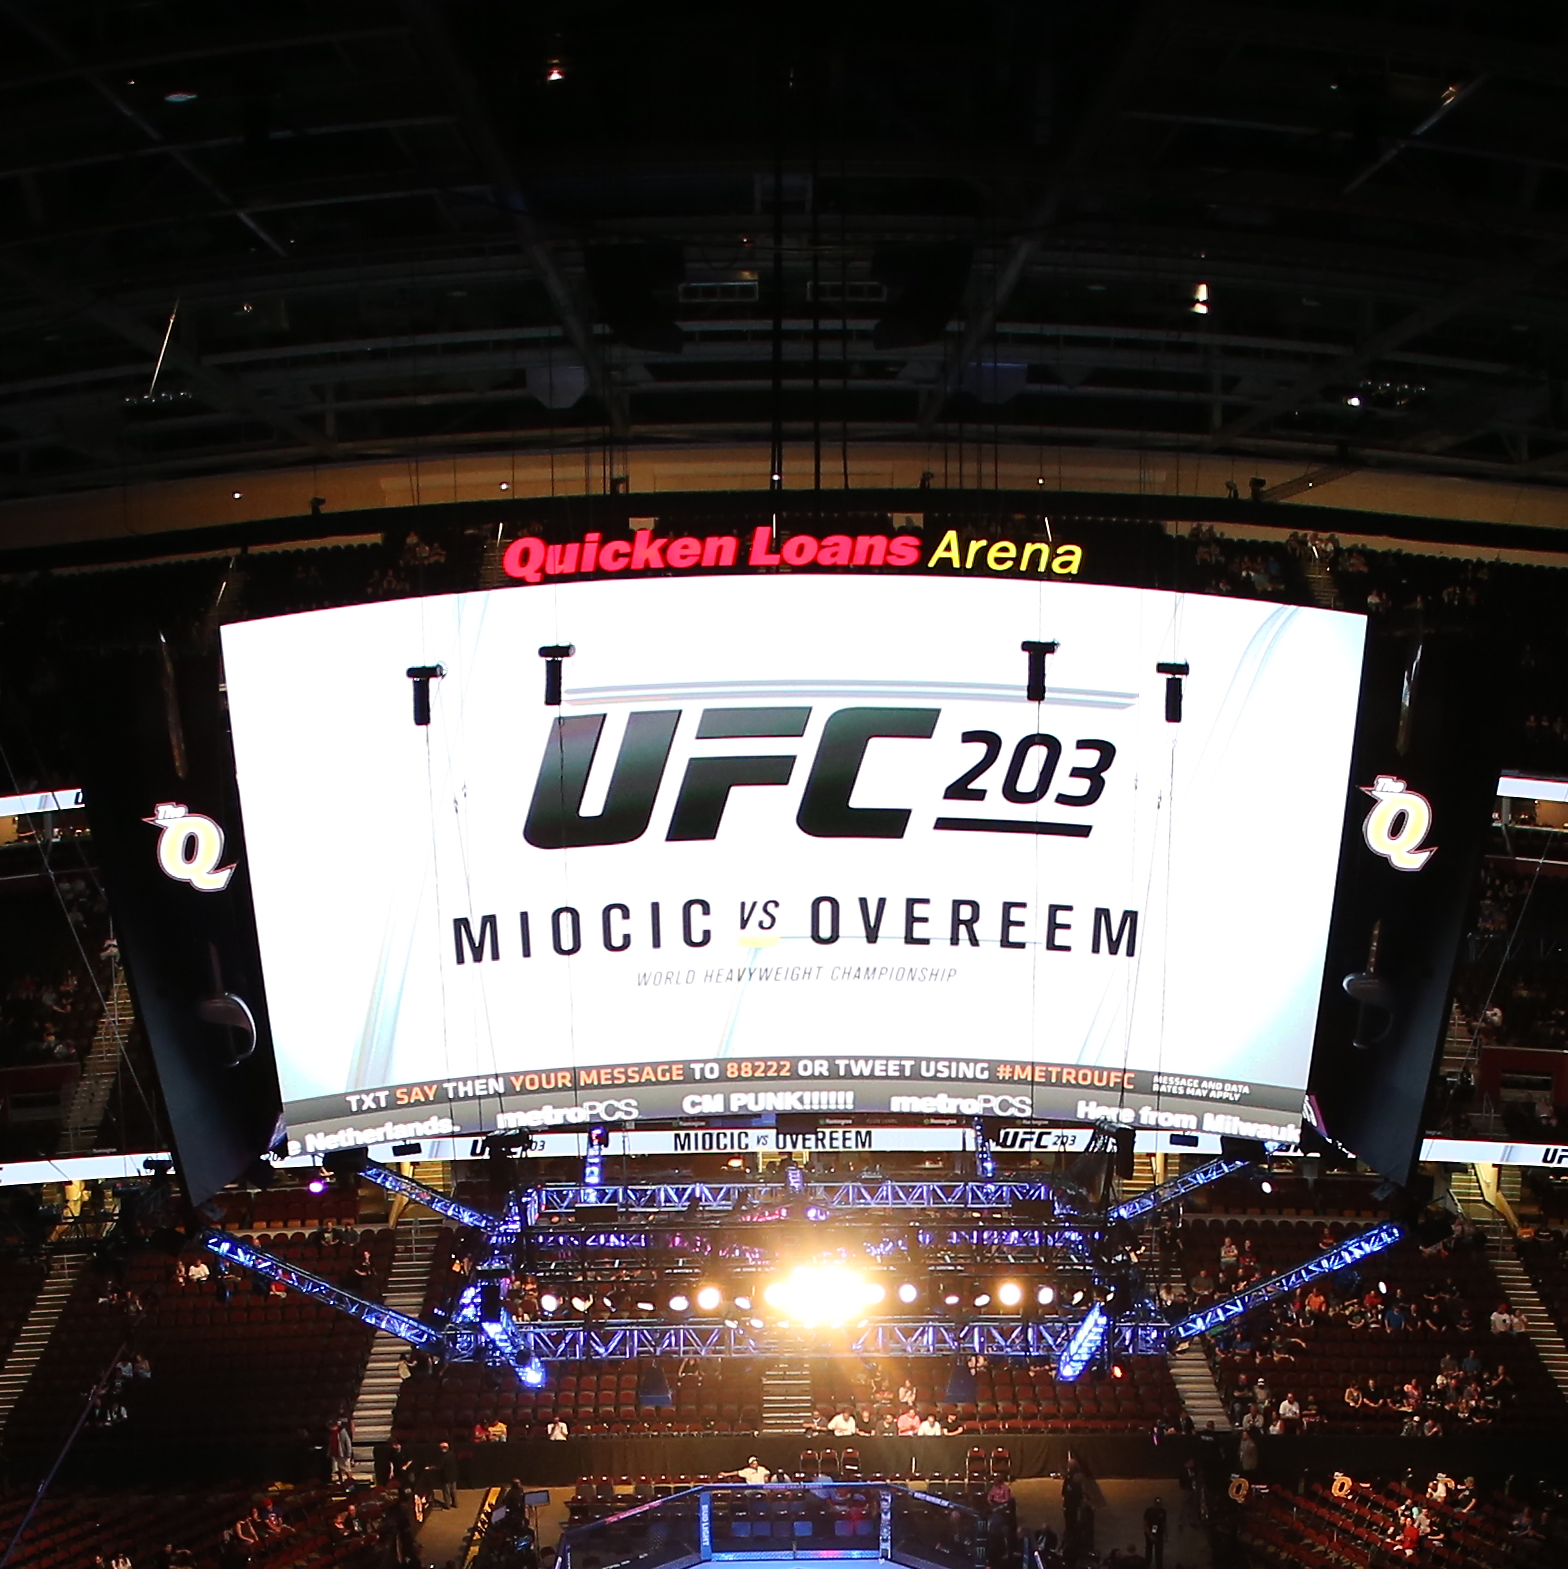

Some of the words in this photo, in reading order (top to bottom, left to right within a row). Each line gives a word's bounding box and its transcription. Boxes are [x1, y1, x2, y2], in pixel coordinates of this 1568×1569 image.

[503, 530, 739, 580] Quicken
[748, 526, 922, 566] Loans
[928, 530, 1083, 575] Arena
[523, 706, 941, 850] UFC
[943, 730, 1117, 807] 203
[1355, 788, 1438, 872] Q
[140, 813, 238, 892] Q
[452, 899, 713, 965] MIOCIC
[809, 896, 1140, 958] OVEREEM
[637, 970, 698, 987] WORLD
[703, 966, 824, 985] HEAVYWEIGHT
[829, 965, 958, 984] CHAMPIONSHIP
[347, 1091, 389, 1111] TXT
[396, 1085, 437, 1105] SAY
[443, 1078, 504, 1098] THEN
[511, 1071, 572, 1091] YOUR
[580, 1064, 683, 1086] MESSAGE
[690, 1063, 719, 1080] TO
[726, 1060, 791, 1078] 88222
[798, 1060, 828, 1077] OR
[835, 1060, 915, 1077] TWEET
[920, 1061, 990, 1079] USING
[997, 1064, 1135, 1089] #METROUFC
[1153, 1084, 1184, 1094] RATES
[1186, 1087, 1207, 1097] MAY
[1209, 1091, 1241, 1101] APPLY
[1154, 1075, 1199, 1088] MESSAGE
[1201, 1081, 1222, 1090] AND
[1225, 1083, 1250, 1094] DATA
[496, 1099, 639, 1129] metroPCS
[683, 1094, 724, 1114] CM
[891, 1093, 1032, 1118] metroPCS
[1076, 1100, 1136, 1123] Here
[1139, 1106, 1197, 1129] from
[674, 1132, 748, 1151] MIOCIC
[776, 1131, 872, 1149] OVEREEM
[1004, 1131, 1052, 1148] UFC
[1053, 1135, 1076, 1147] 203
[702, 1504, 710, 1522] BUD
[702, 1522, 711, 1546] LIGHT
